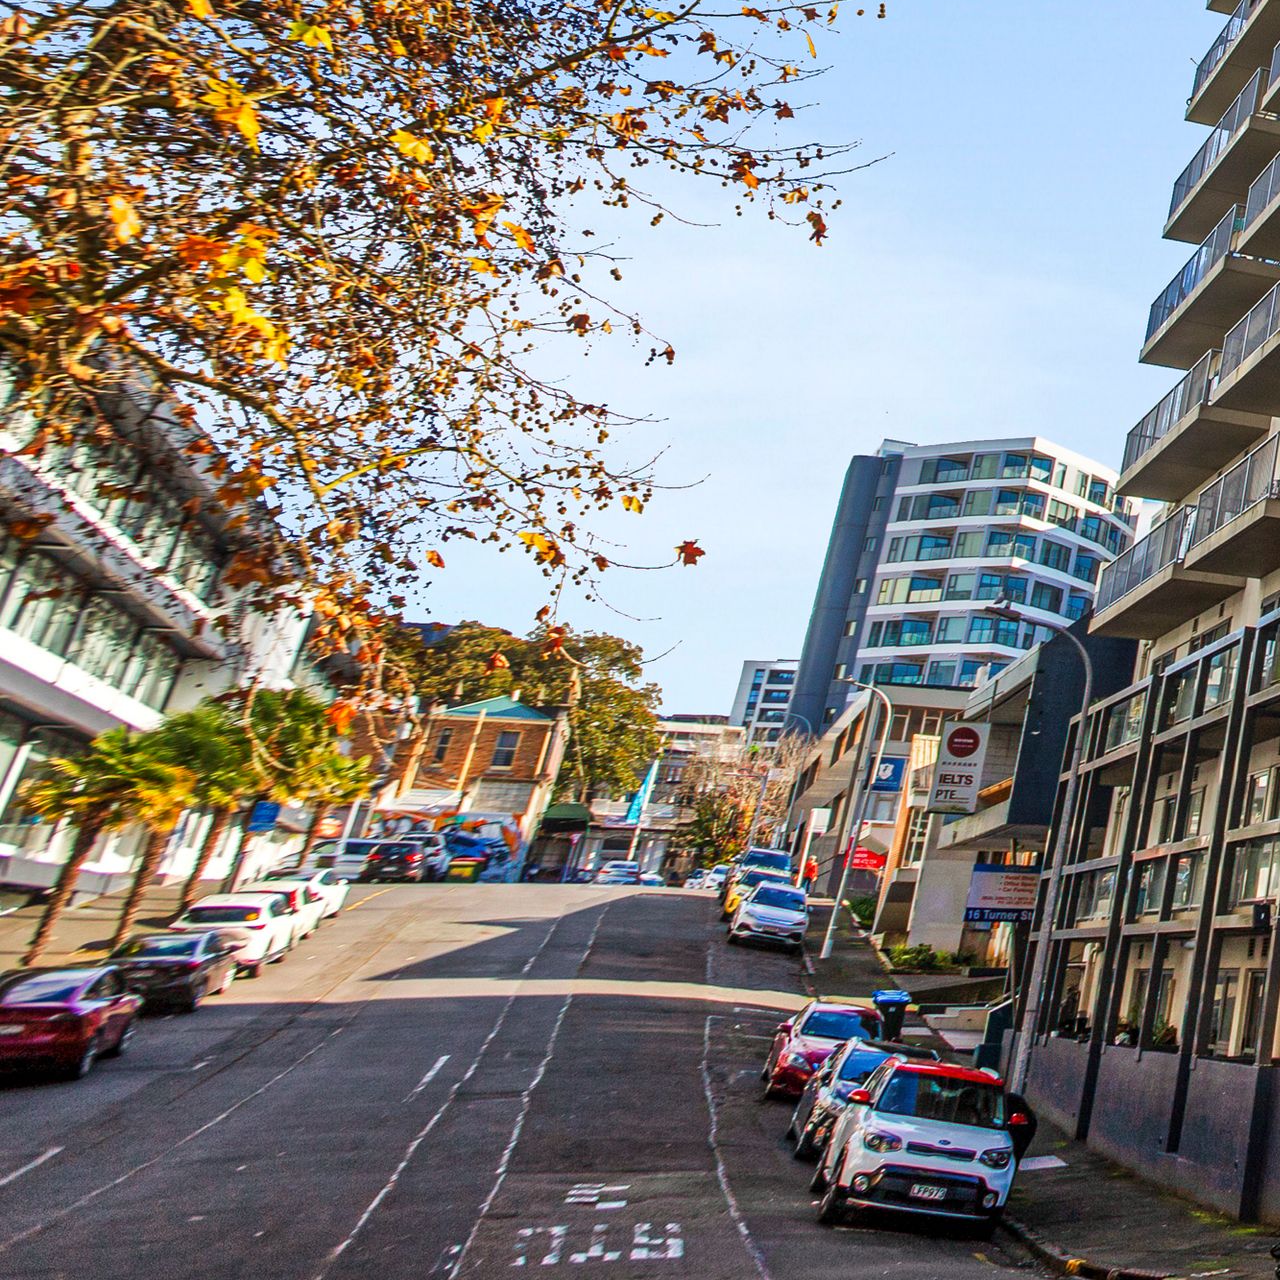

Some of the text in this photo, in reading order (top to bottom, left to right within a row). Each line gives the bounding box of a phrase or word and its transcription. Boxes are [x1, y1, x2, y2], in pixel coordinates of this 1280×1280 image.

[938, 773, 974, 786] IELTS
[935, 789, 957, 800] PTE
[967, 909, 980, 920] 16
[983, 909, 1019, 920] Turner
